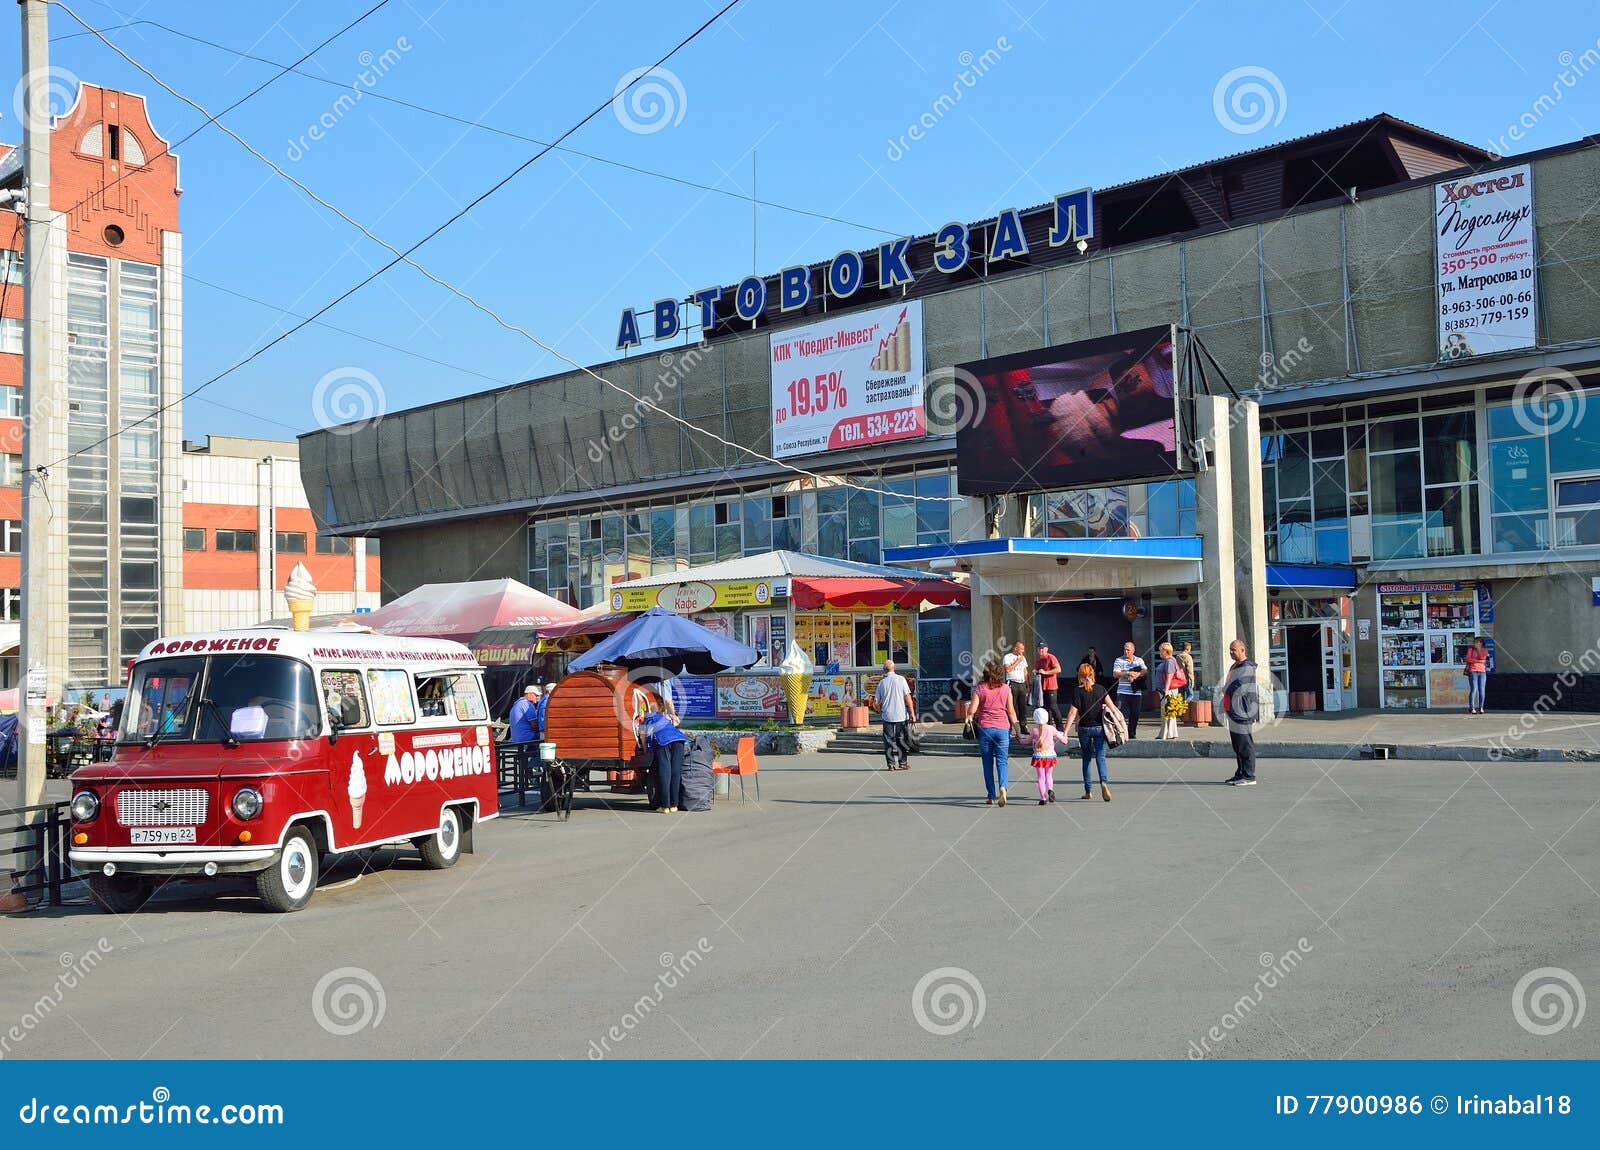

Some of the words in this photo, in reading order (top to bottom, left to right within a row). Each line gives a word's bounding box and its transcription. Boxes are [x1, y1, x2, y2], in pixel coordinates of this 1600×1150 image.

[1441, 172, 1525, 203] Хостел
[1437, 201, 1531, 250] Подсолнух
[1442, 247, 1480, 259] Стоимость
[1481, 238, 1528, 253] проживания
[616, 187, 1094, 350] АВТОВОКЗАЛ
[1441, 253, 1497, 275] 350-500
[1500, 251, 1531, 263] руб/сут.
[1440, 282, 1456, 297] ул.
[1458, 269, 1518, 291] Матросова
[1519, 268, 1532, 280] 10
[1441, 290, 1532, 315] 8-963-506-00-66
[1444, 316, 1479, 331] 8(3852)
[1481, 306, 1529, 326] 779-159
[773, 344, 791, 362] КПК
[865, 375, 907, 391] Сбережения
[865, 384, 920, 404] застрахованы!!!
[775, 408, 787, 424] до
[787, 369, 848, 417] 19,5%
[839, 422, 864, 442] тел.
[867, 409, 917, 438] 534-223
[783, 440, 797, 451] Союза
[674, 597, 697, 609] Кафе
[150, 638, 280, 656] МОРОЖЕНОЕ
[384, 745, 491, 787] МОРОЖЕНОЕ
[179, 829, 192, 839] 22
